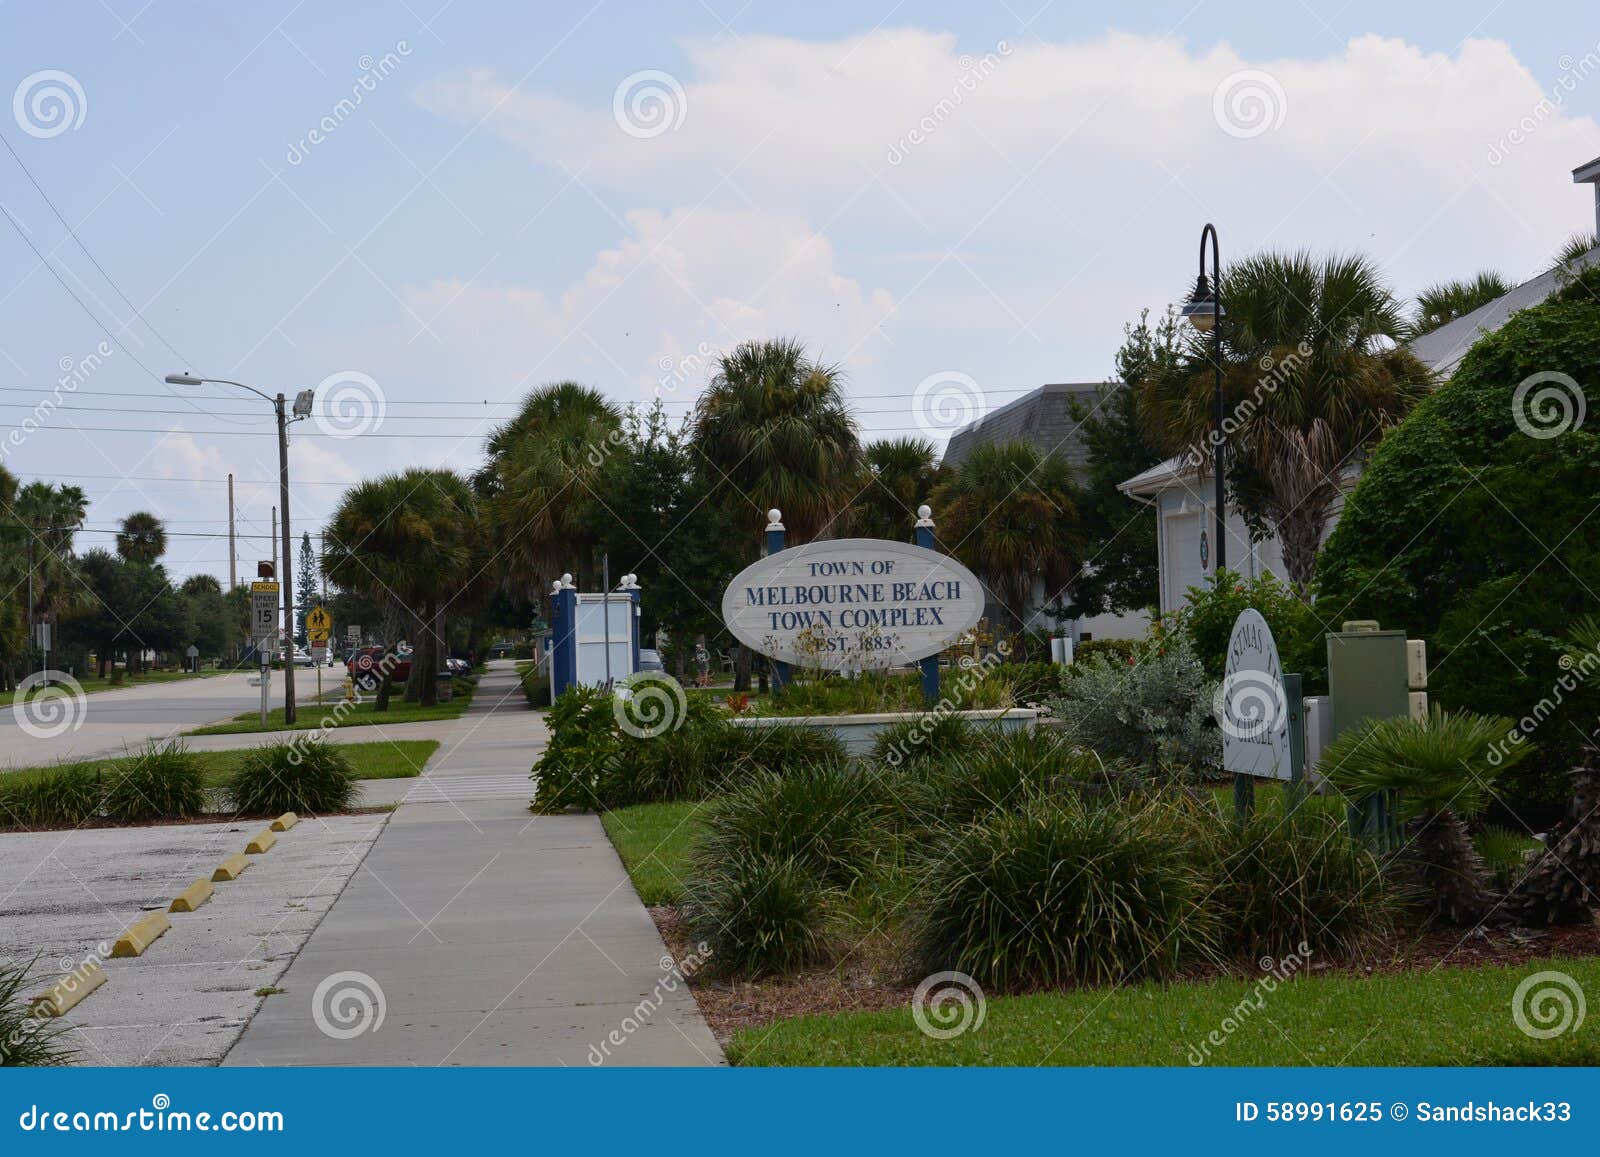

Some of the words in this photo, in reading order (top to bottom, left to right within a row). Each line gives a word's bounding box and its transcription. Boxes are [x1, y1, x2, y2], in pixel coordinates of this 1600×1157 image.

[808, 561, 864, 577] TOWN
[871, 560, 895, 575] OF
[745, 584, 885, 606] MELBOURNE
[892, 581, 961, 601] BEACH
[258, 610, 272, 623] 15
[768, 610, 832, 630] TOWN
[840, 607, 944, 628] COMPLEX
[859, 635, 892, 651] 1883
